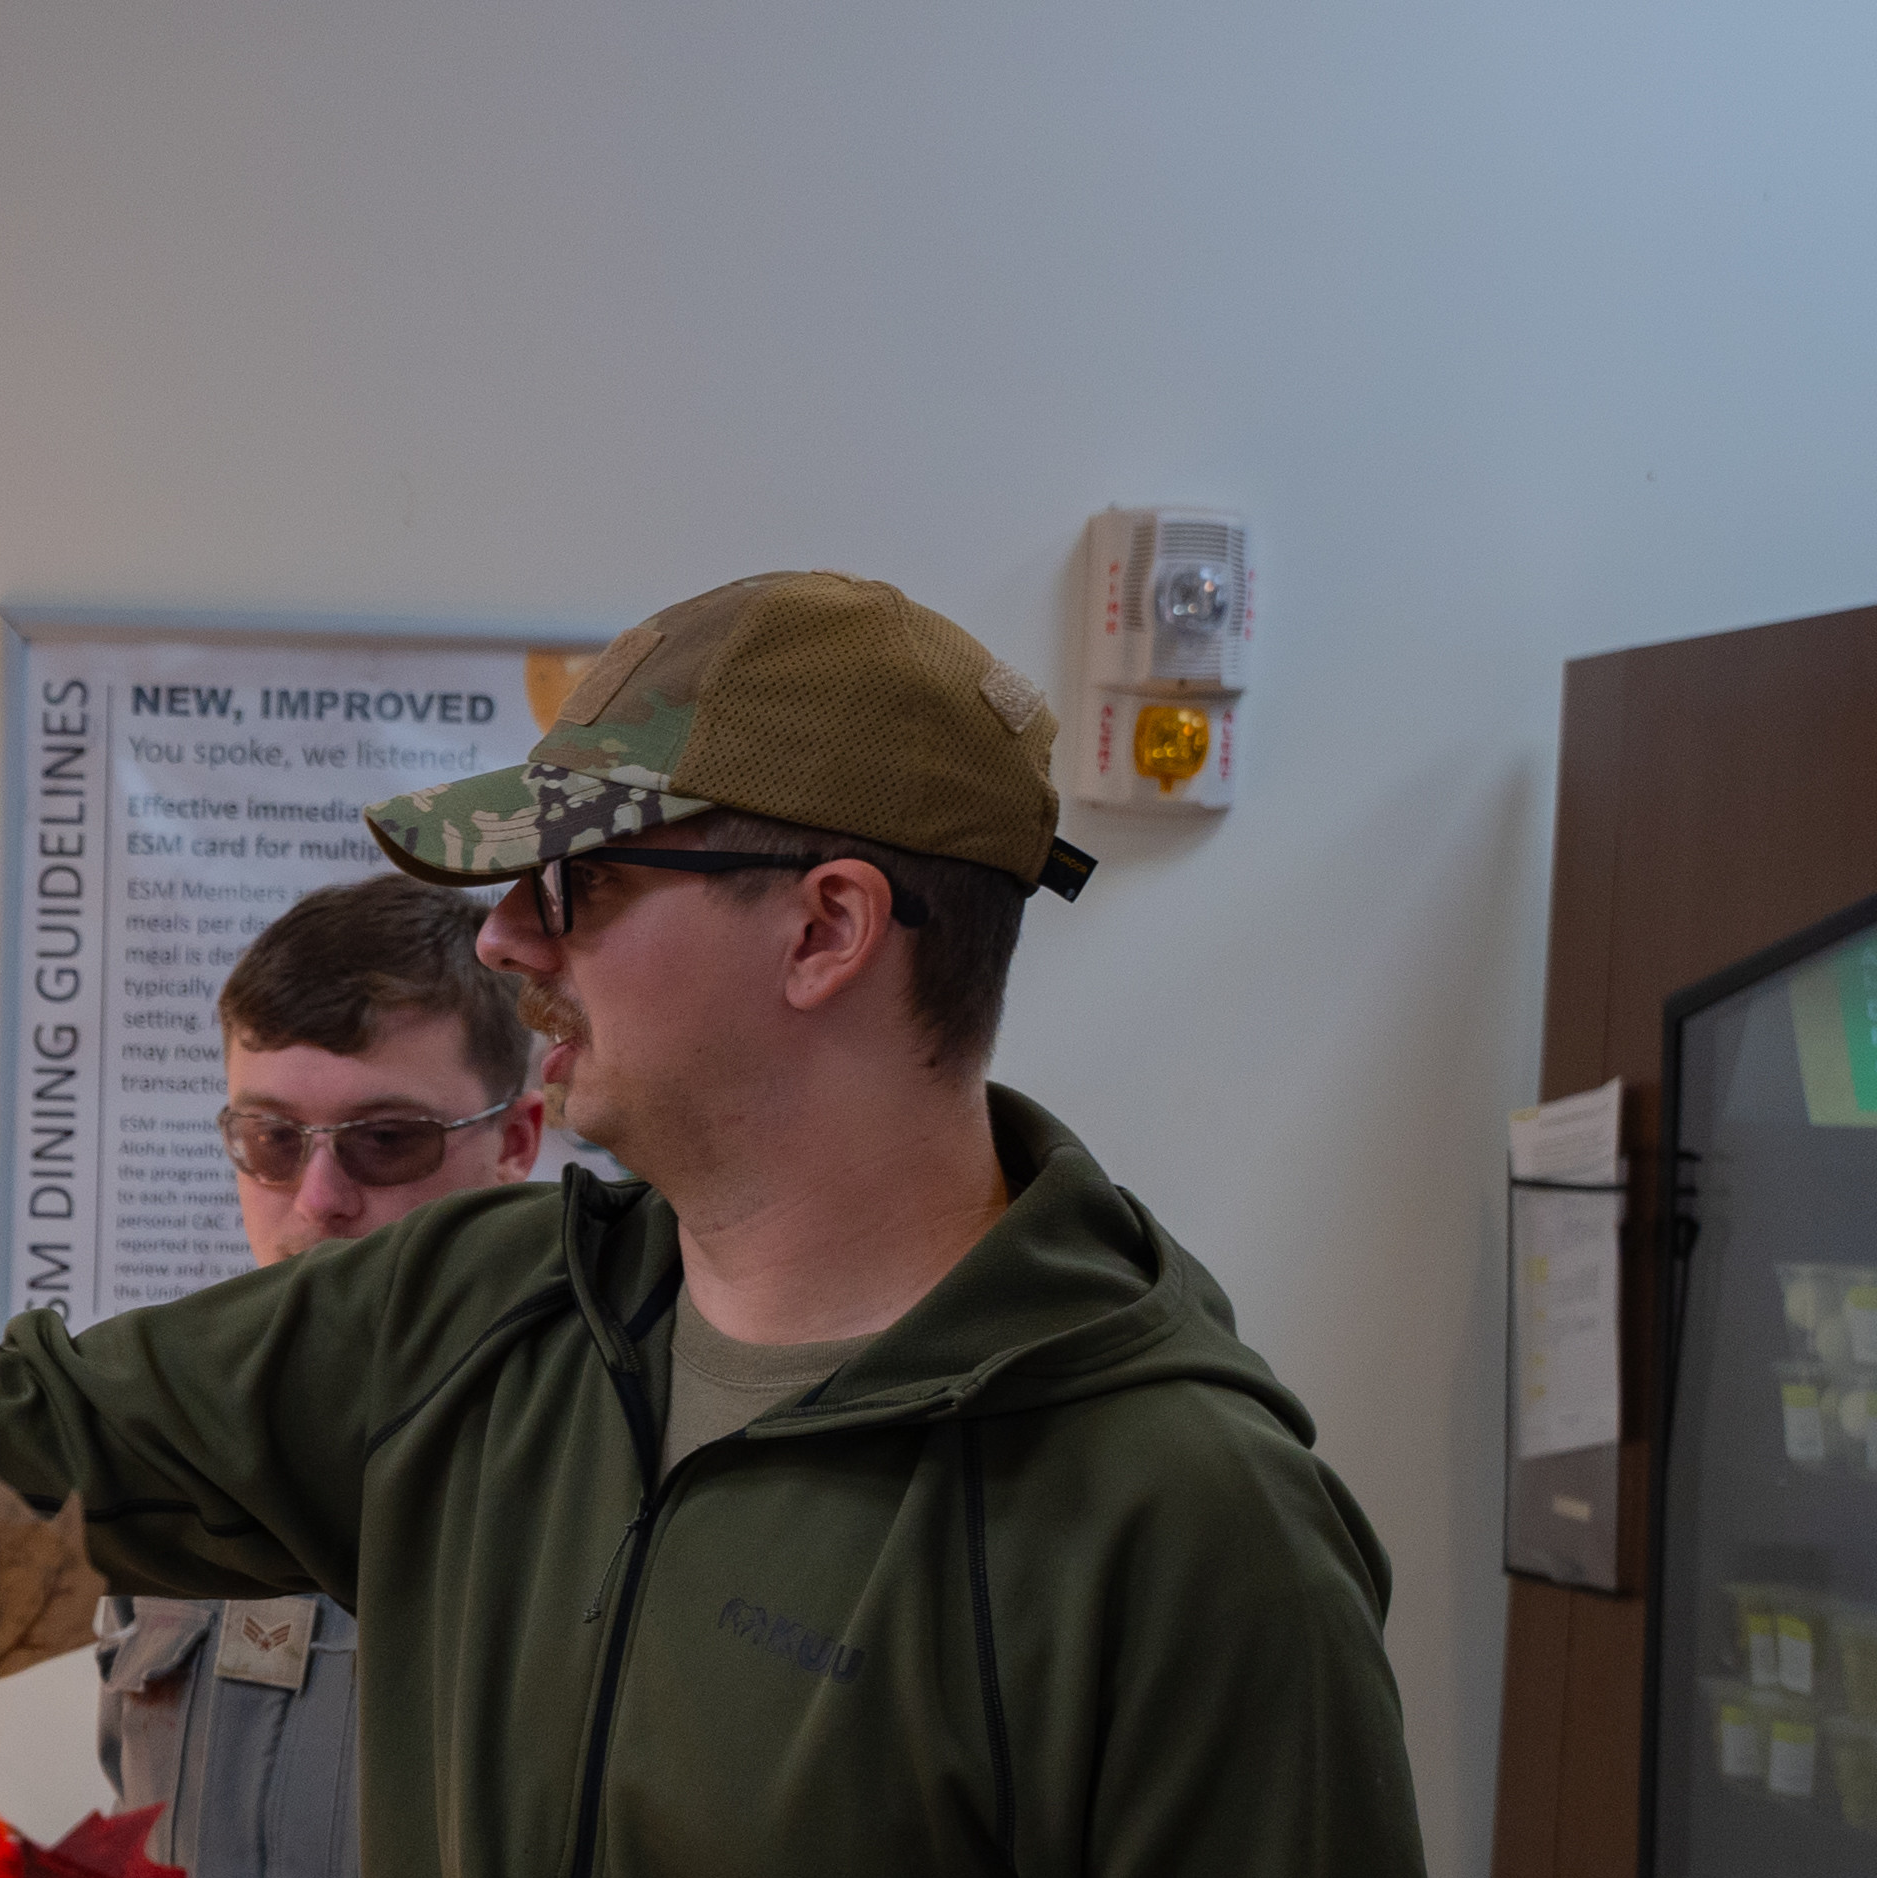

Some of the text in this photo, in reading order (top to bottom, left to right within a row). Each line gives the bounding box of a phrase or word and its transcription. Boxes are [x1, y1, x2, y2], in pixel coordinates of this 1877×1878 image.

[130, 685, 495, 726] NEW, IMPROVED
[128, 736, 485, 771] You spoke, we listened.
[126, 795, 364, 824] Effective immedia
[126, 832, 383, 866] ESM card for multip
[126, 879, 175, 900] ESM
[182, 879, 287, 902] Members
[125, 914, 268, 936] meals per da
[125, 947, 178, 966] meal
[26, 679, 90, 1322] SM DINING GUIDELINES
[124, 977, 214, 1001] typically
[122, 1043, 220, 1064] may now
[121, 1074, 229, 1095] transactio
